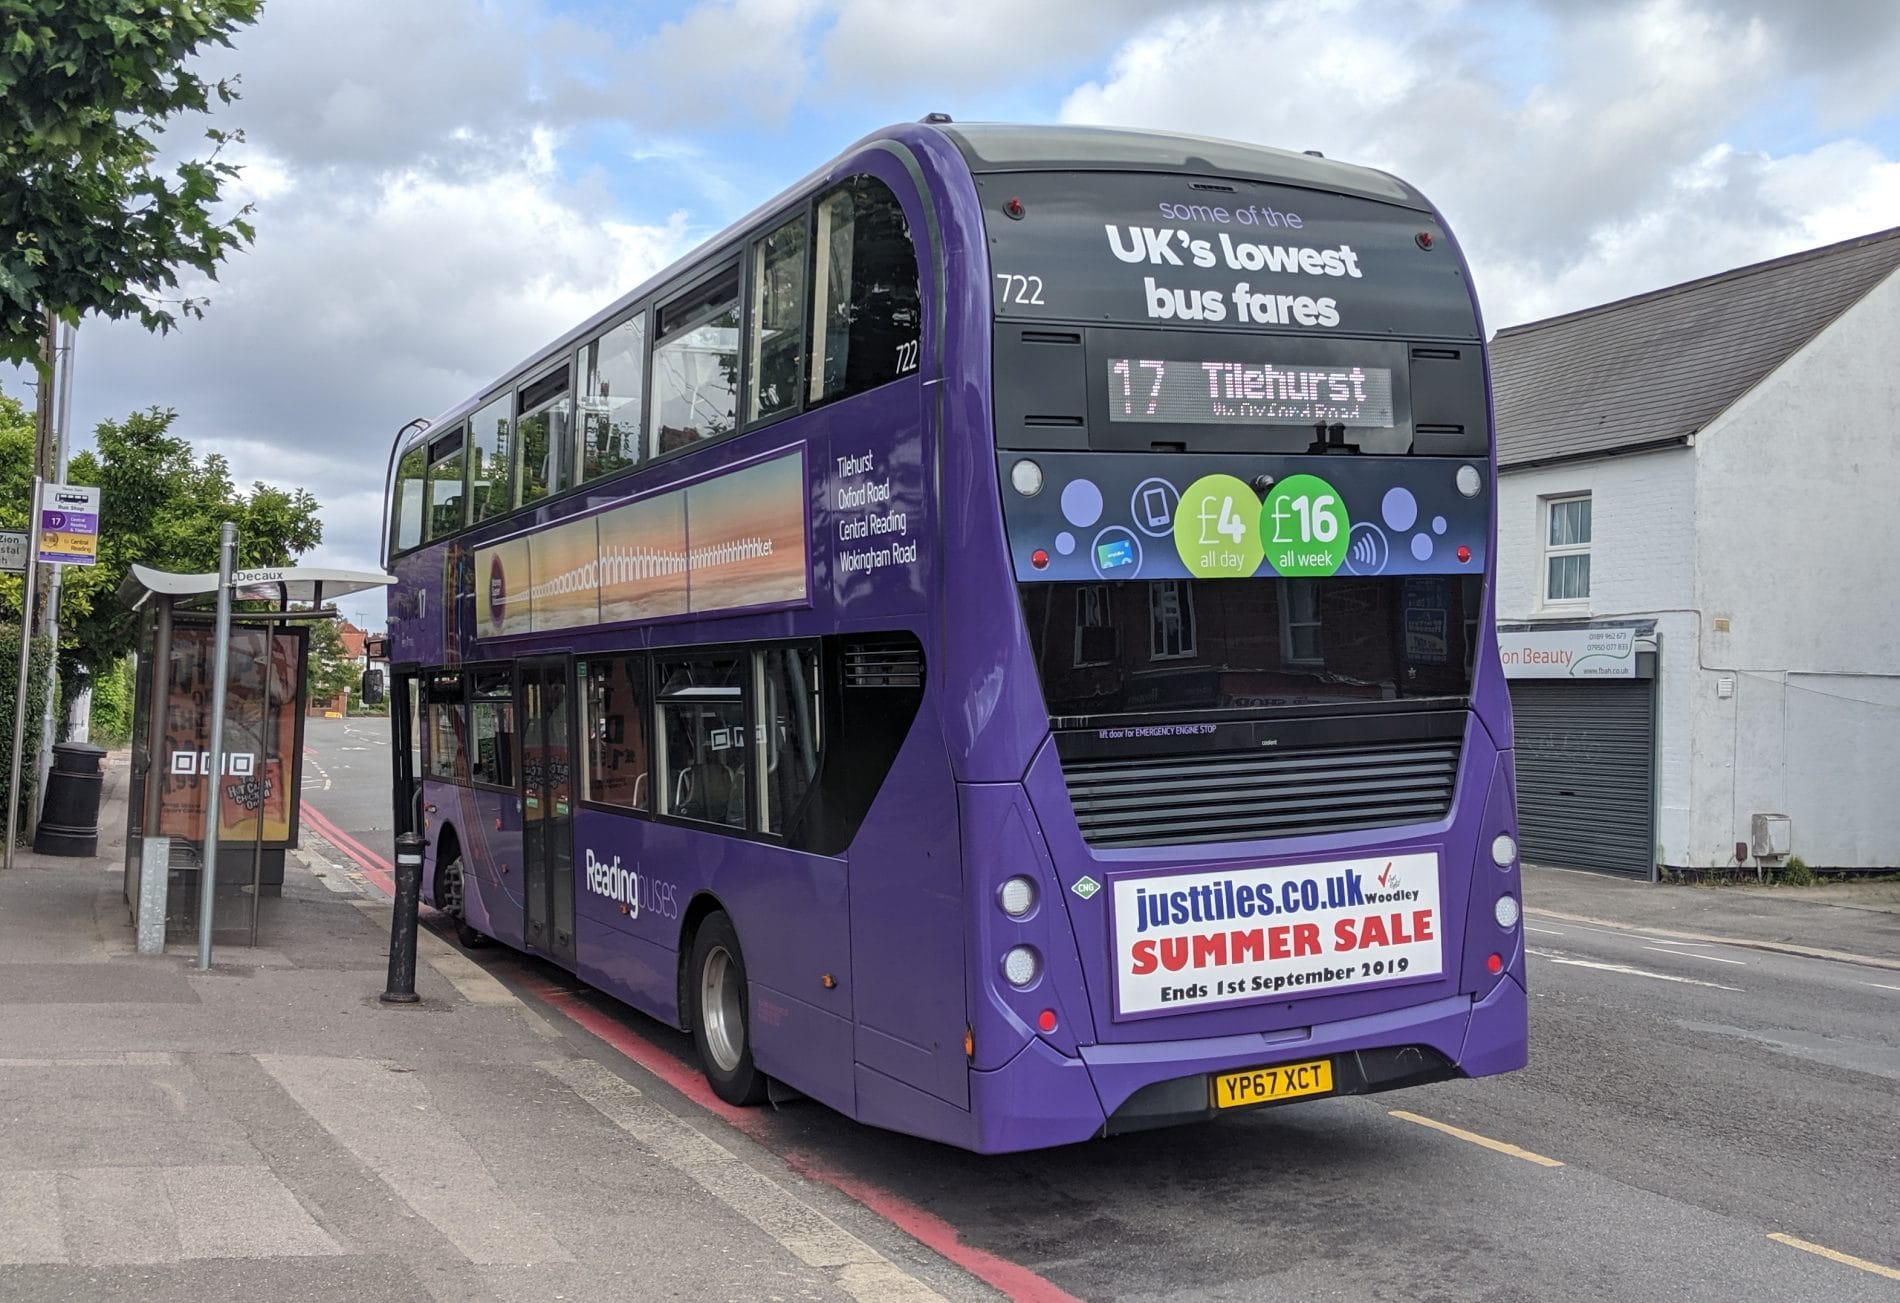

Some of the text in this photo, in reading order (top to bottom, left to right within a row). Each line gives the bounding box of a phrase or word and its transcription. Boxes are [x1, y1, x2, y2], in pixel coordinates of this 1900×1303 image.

[1159, 202, 1303, 229] some of the
[1218, 233, 1363, 279] lowest
[997, 274, 1045, 305] 722
[1144, 277, 1340, 327] bus fares
[896, 339, 918, 375] 722
[1113, 360, 1367, 415] 17 Tilehurst
[837, 449, 874, 479] Tilehurst
[838, 477, 890, 510] Oxford Road
[51, 517, 61, 526] 17
[839, 509, 907, 541] Central Reading
[1197, 496, 1246, 544] £4
[1271, 495, 1338, 543] £16
[840, 539, 917, 575] Wokingham Road
[1200, 550, 1245, 571] all day
[1279, 550, 1333, 567] all week
[237, 571, 284, 581] Decaux
[1523, 647, 1573, 668] Beauty
[1109, 729, 1124, 739] door
[1125, 729, 1135, 738] for
[1135, 727, 1175, 738] EMERGENCY
[1175, 725, 1200, 736] ENGINE
[1200, 724, 1217, 734] STOP
[586, 848, 678, 920] Reading buses
[1078, 883, 1095, 893] CNG
[1136, 868, 1364, 932] justtiles.co.uk
[1365, 889, 1419, 904] Woodley
[1131, 909, 1434, 975] SUMMER SALE
[1161, 957, 1409, 1002] Ends 1st September 2019
[1226, 1065, 1322, 1101] YP67 XCT
